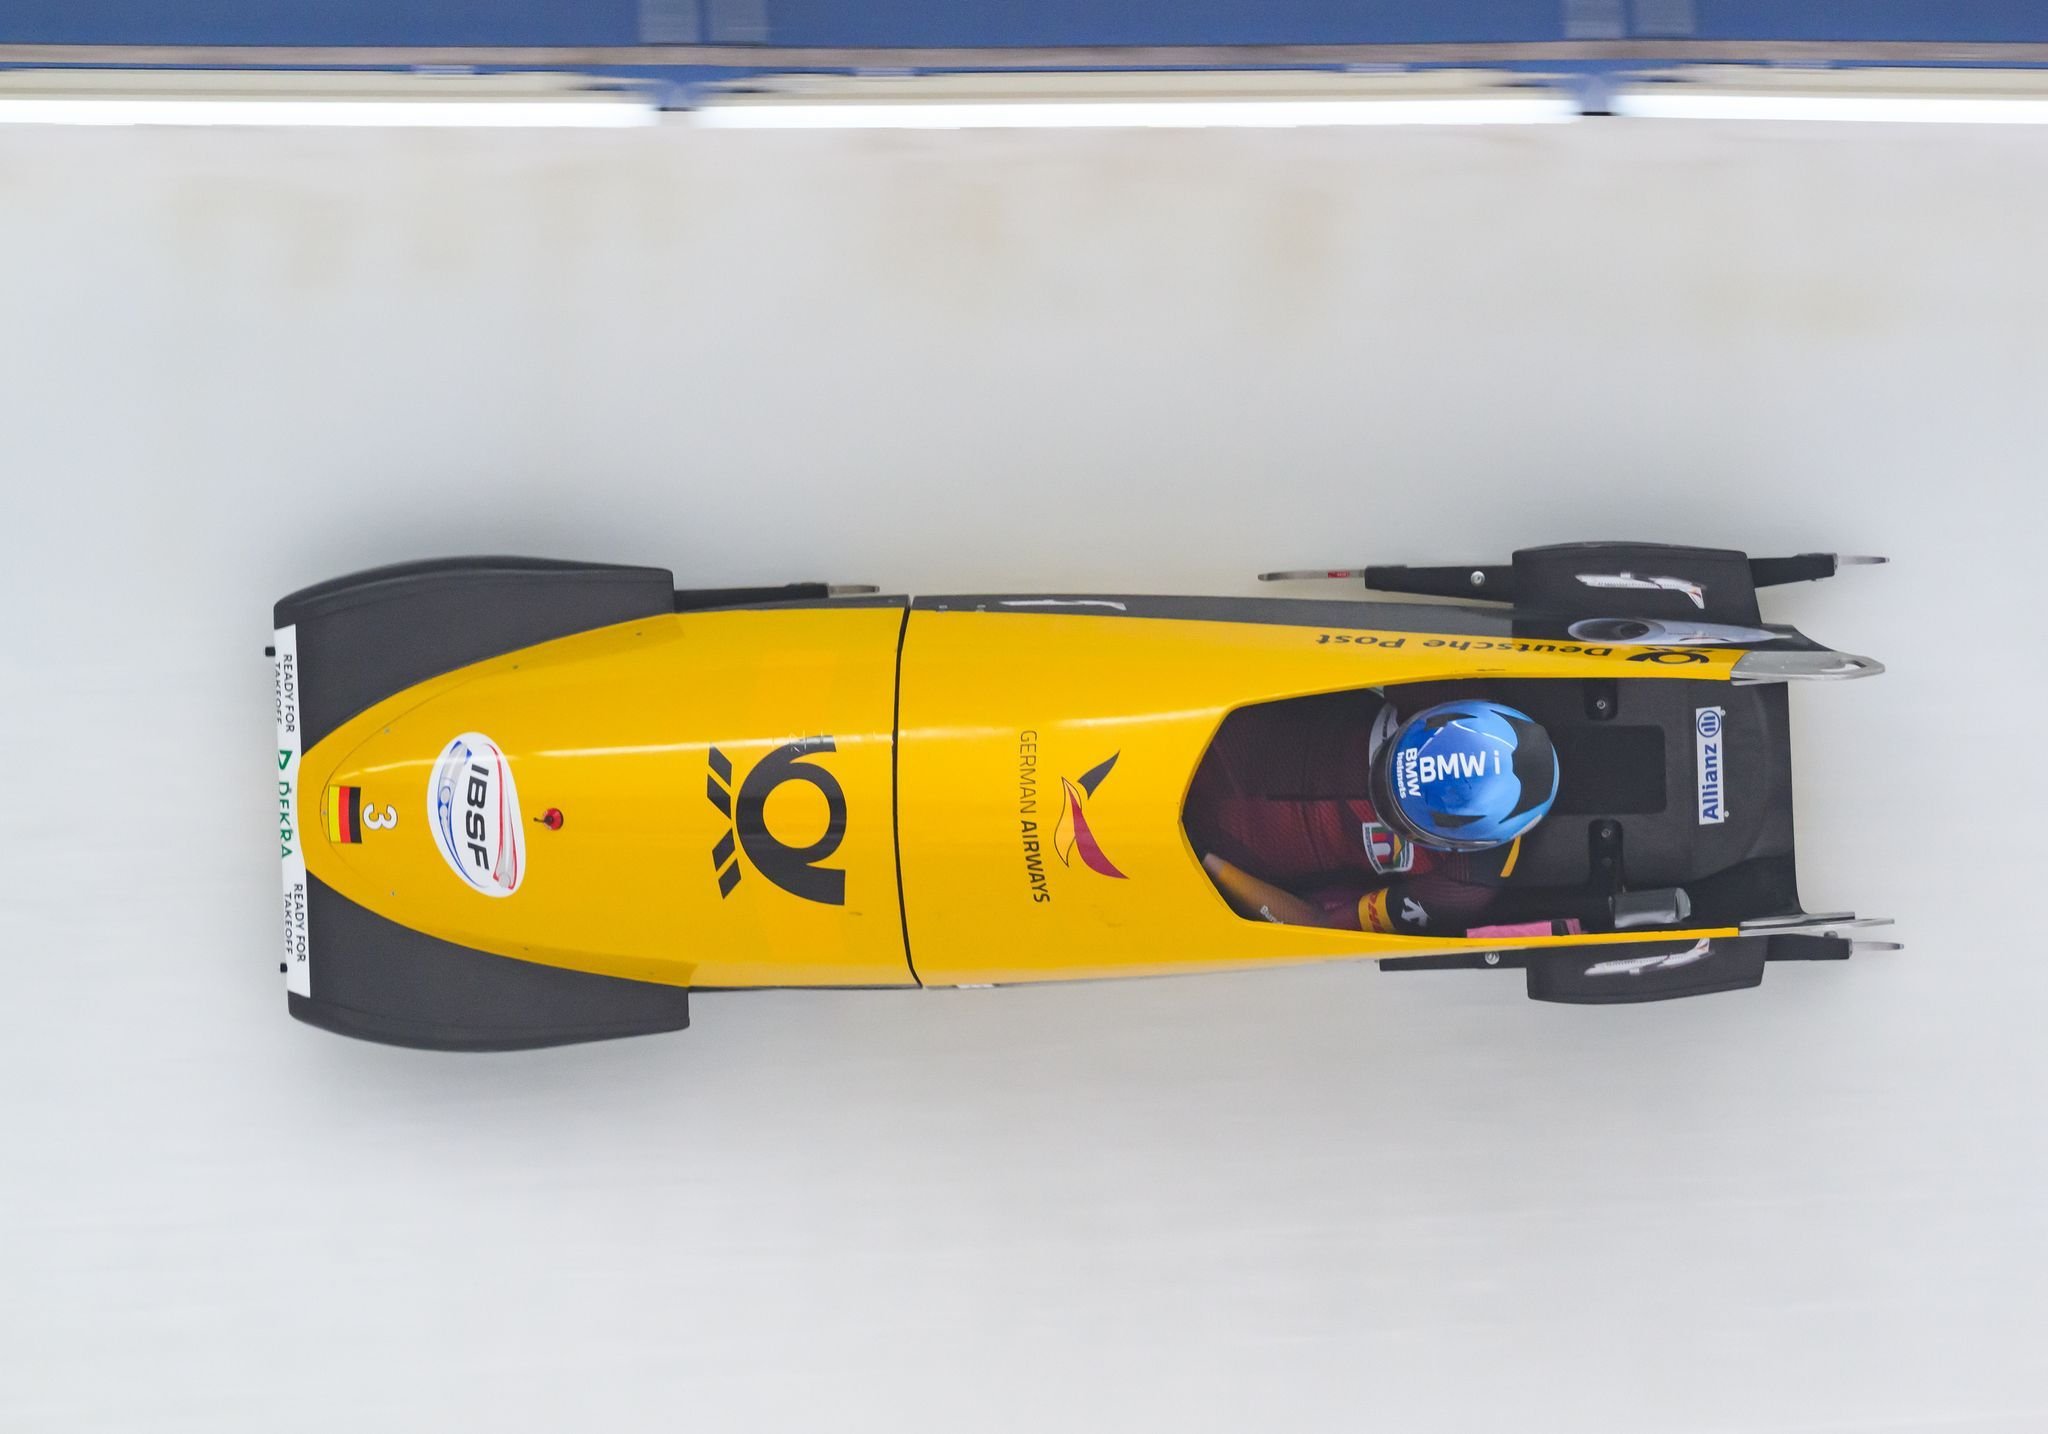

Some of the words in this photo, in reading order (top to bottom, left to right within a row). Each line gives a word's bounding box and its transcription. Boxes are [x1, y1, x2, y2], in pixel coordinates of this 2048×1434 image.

[1316, 634, 1406, 648] Post
[1423, 639, 1613, 656] Deutsche
[283, 654, 294, 701] READY
[285, 705, 295, 733] FOR
[1019, 730, 1037, 814] GERMAN
[1405, 747, 1421, 797] BMW
[1419, 751, 1486, 783] BMW
[1702, 743, 1719, 820] Allianz
[279, 781, 293, 858] DEKRA
[363, 803, 398, 830] 3
[466, 763, 489, 871] IBSF
[1021, 820, 1050, 903] AIRWAYS
[284, 891, 293, 954] TAKEOFF
[294, 883, 304, 930] READY
[296, 935, 306, 962] FOR
